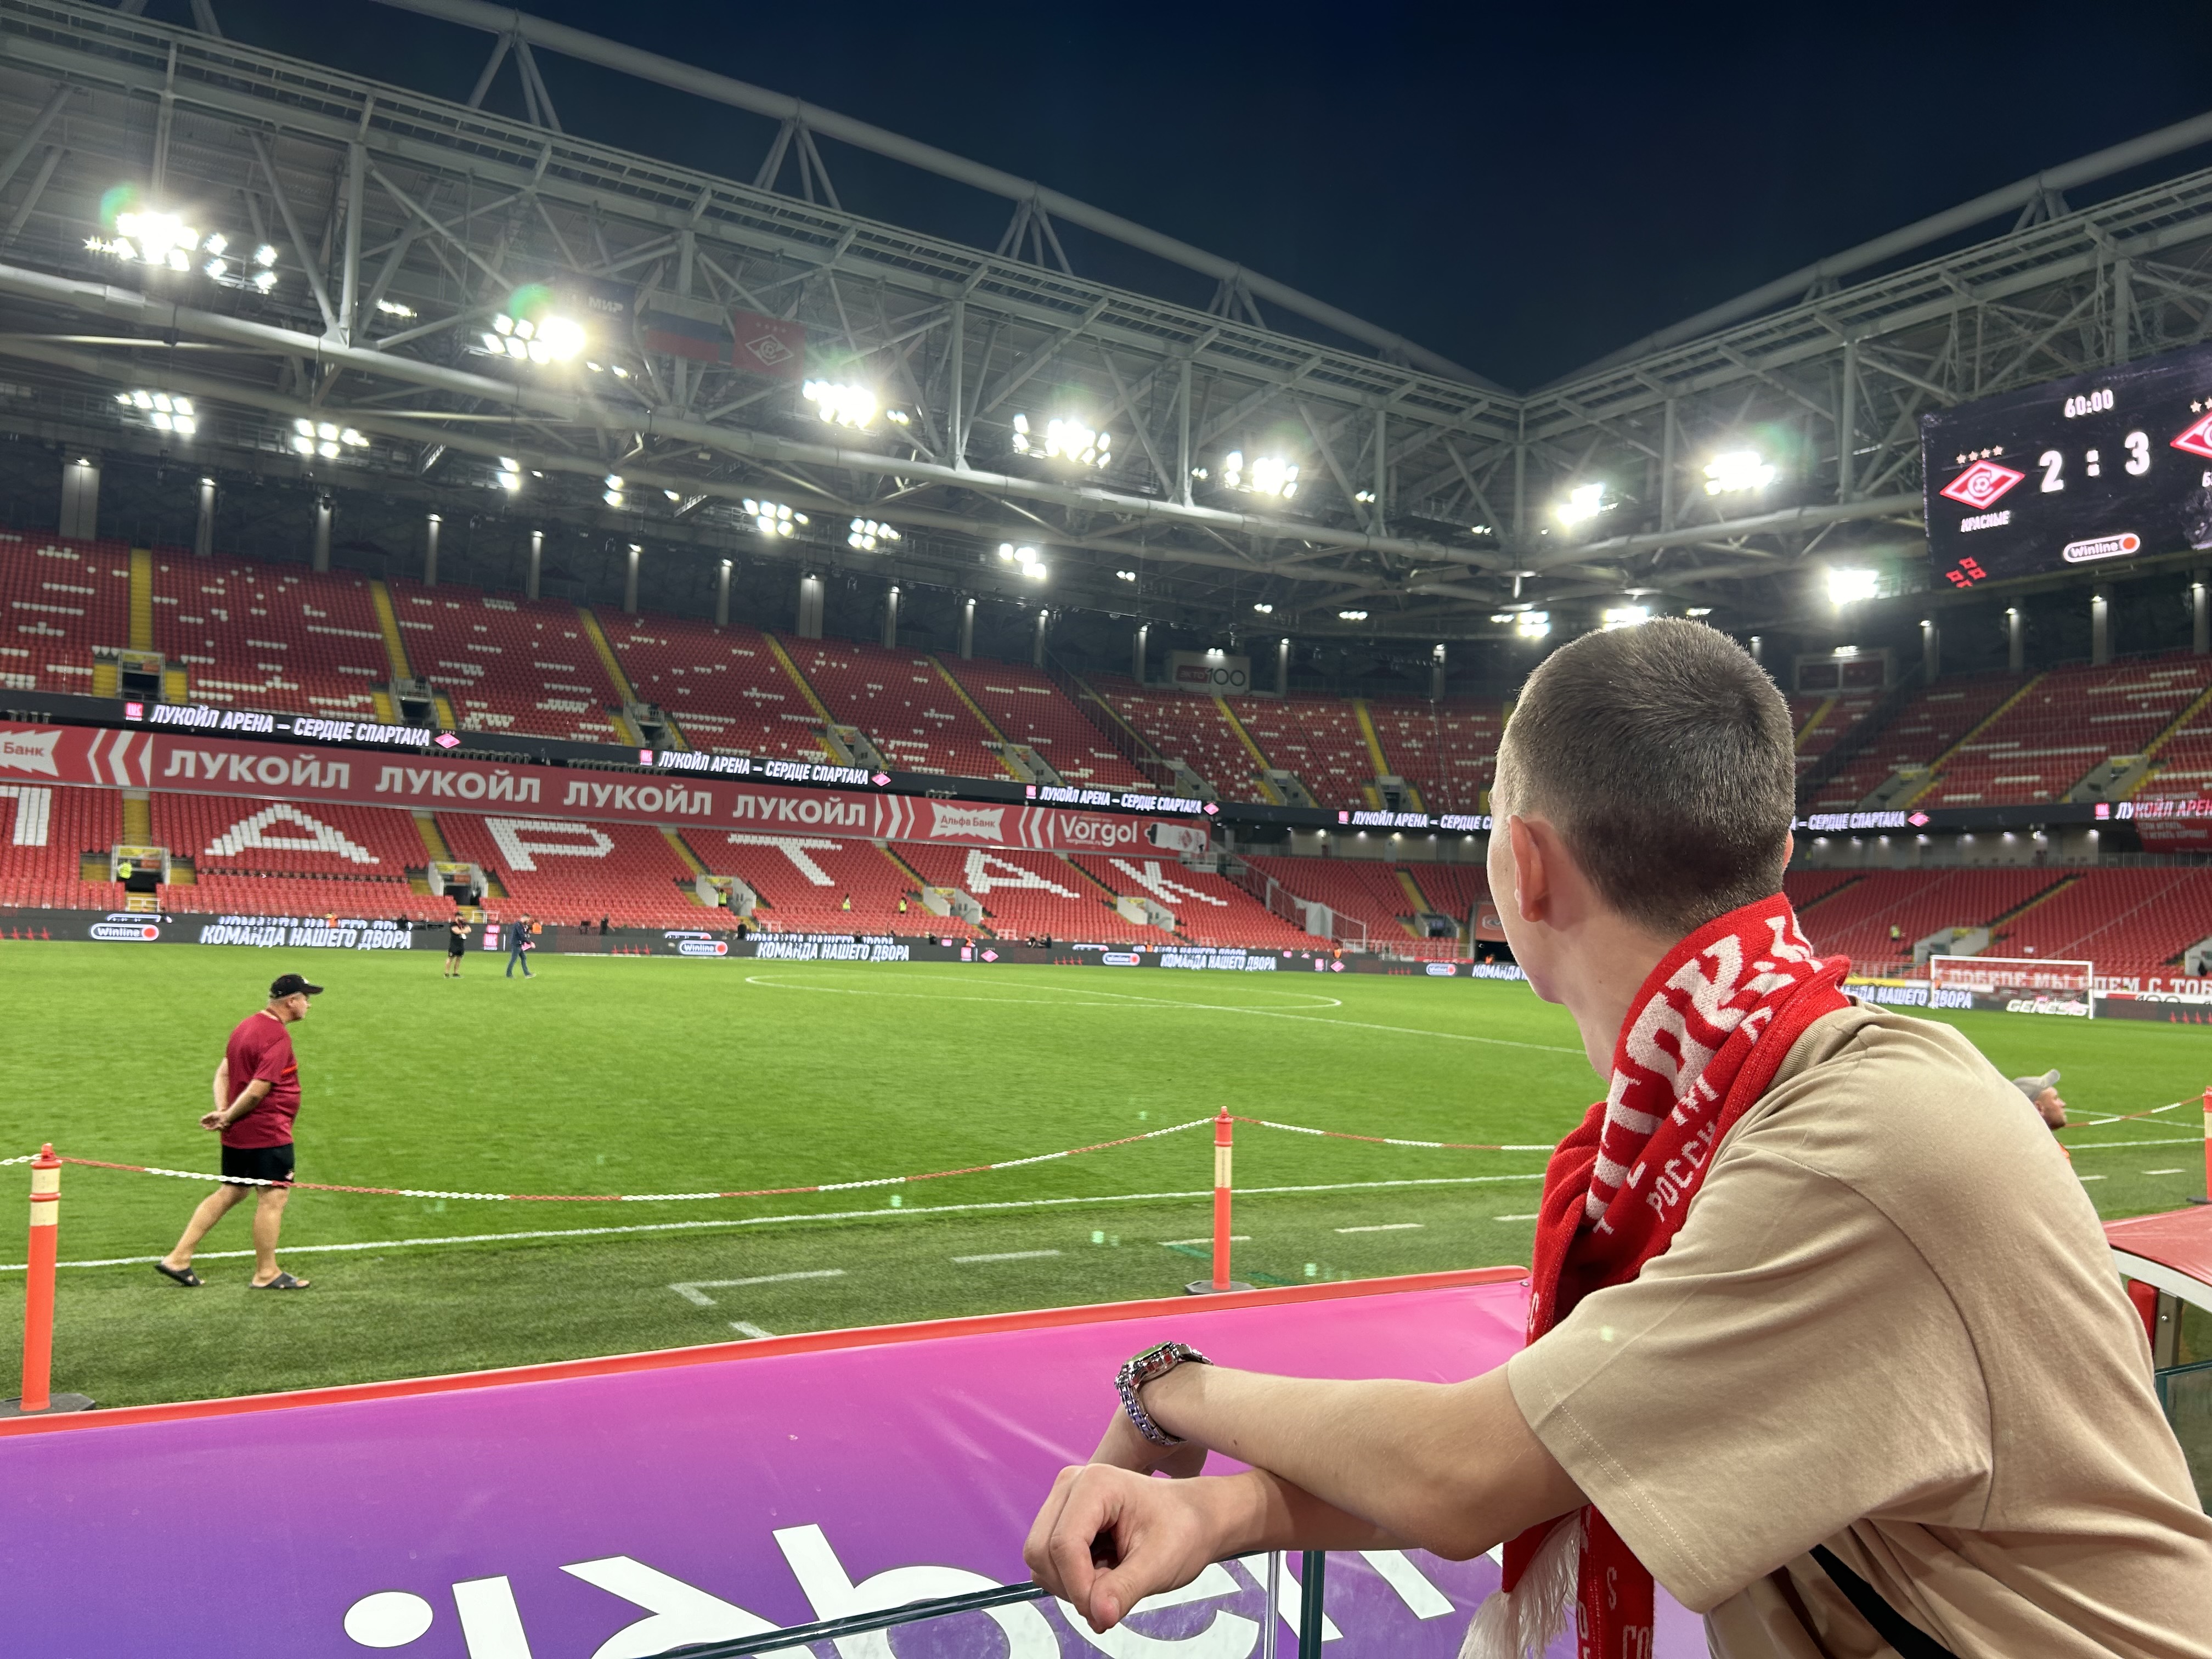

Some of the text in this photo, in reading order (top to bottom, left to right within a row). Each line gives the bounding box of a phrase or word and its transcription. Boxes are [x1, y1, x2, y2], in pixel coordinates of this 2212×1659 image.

[2064, 389, 2113, 418] 60:00
[2039, 450, 2064, 493] 2
[2125, 432, 2151, 476] 3
[1961, 511, 2009, 532] КРАСНЫЕ
[150, 704, 219, 728] ЛУКОЙЛ
[221, 712, 273, 733] АРЕНА
[294, 718, 353, 742] СЕРДЦЕ
[357, 723, 430, 746] СПАРТАКА
[3, 742, 44, 757] Банк
[165, 749, 351, 791] ЛУКОЙЛ
[658, 751, 710, 771] ЛУКОЙЛ
[711, 754, 751, 775] АРЕНА
[765, 761, 810, 782] СЕРДЦЕ
[814, 765, 868, 785] СПАРТАКА
[375, 767, 540, 803] ЛУКОЙЛ
[564, 782, 712, 816] ЛУКОЙЛ
[733, 795, 866, 827] ЛУКОЙЛ
[1040, 785, 1079, 805] ЛУКОЙЛ
[1079, 789, 1110, 806] АРЕНА
[1121, 793, 1156, 812] СЕРДЦЕ
[941, 815, 995, 828] Альфа Банк
[1060, 815, 1137, 847] Vorgol
[1352, 810, 1393, 826] ЛУКОЙЛ
[1395, 813, 1429, 828] АРЕНА
[1440, 814, 1480, 831] СЕРДЦЕ
[1808, 813, 1849, 832] СЕРДЦЕ
[1849, 811, 1905, 828] СПАРТАКА
[97, 927, 140, 937] Winline
[200, 925, 412, 950] КОМАНДА НАШЕГО ДВОРА
[757, 942, 910, 962] КОМАНДА НАШЕГО ДВОРА
[1160, 953, 1276, 971] КОМАНДА НАШЕГО ДВОРА
[1472, 965, 1520, 980] КОМАНДА
[1876, 988, 1927, 1006] НАШЕГО
